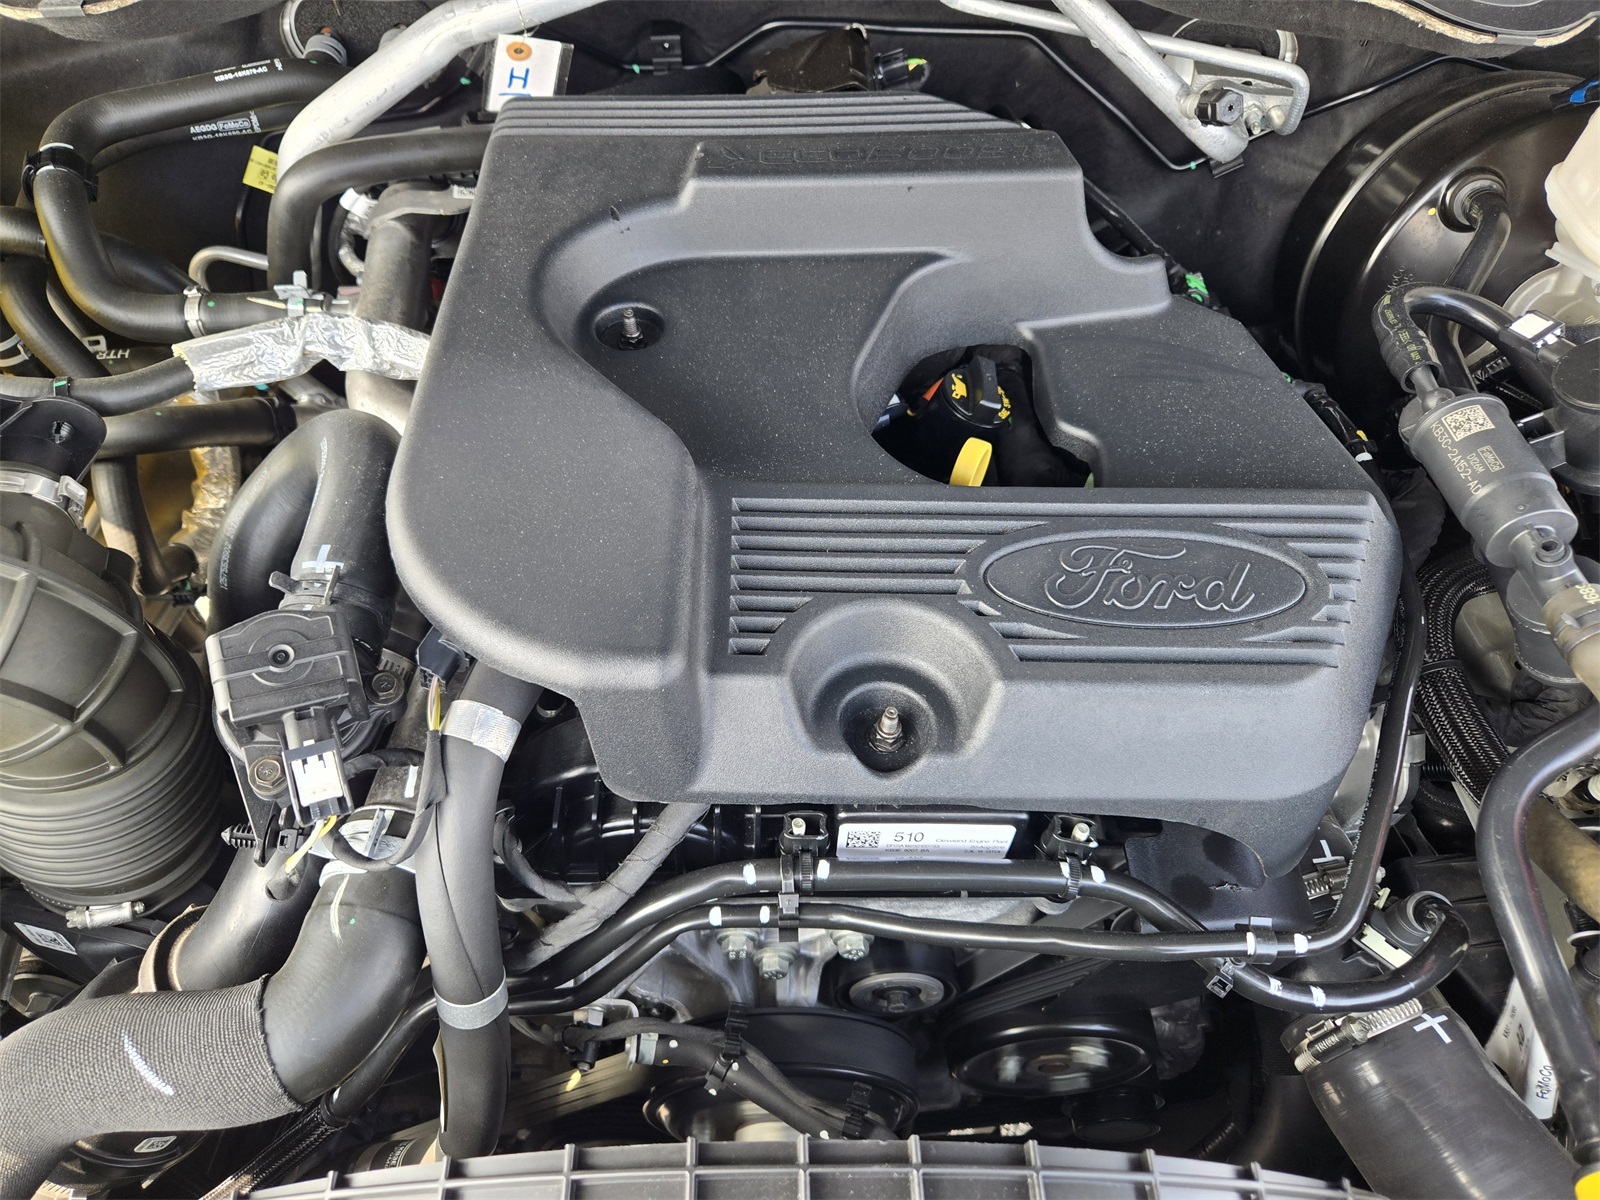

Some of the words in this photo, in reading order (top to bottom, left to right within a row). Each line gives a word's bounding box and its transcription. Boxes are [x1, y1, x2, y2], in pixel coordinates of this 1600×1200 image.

[219, 119, 250, 131] FoMoCo
[1481, 446, 1503, 471] FoMoCo
[1045, 544, 1255, 612] Ford
[893, 831, 925, 843] 510
